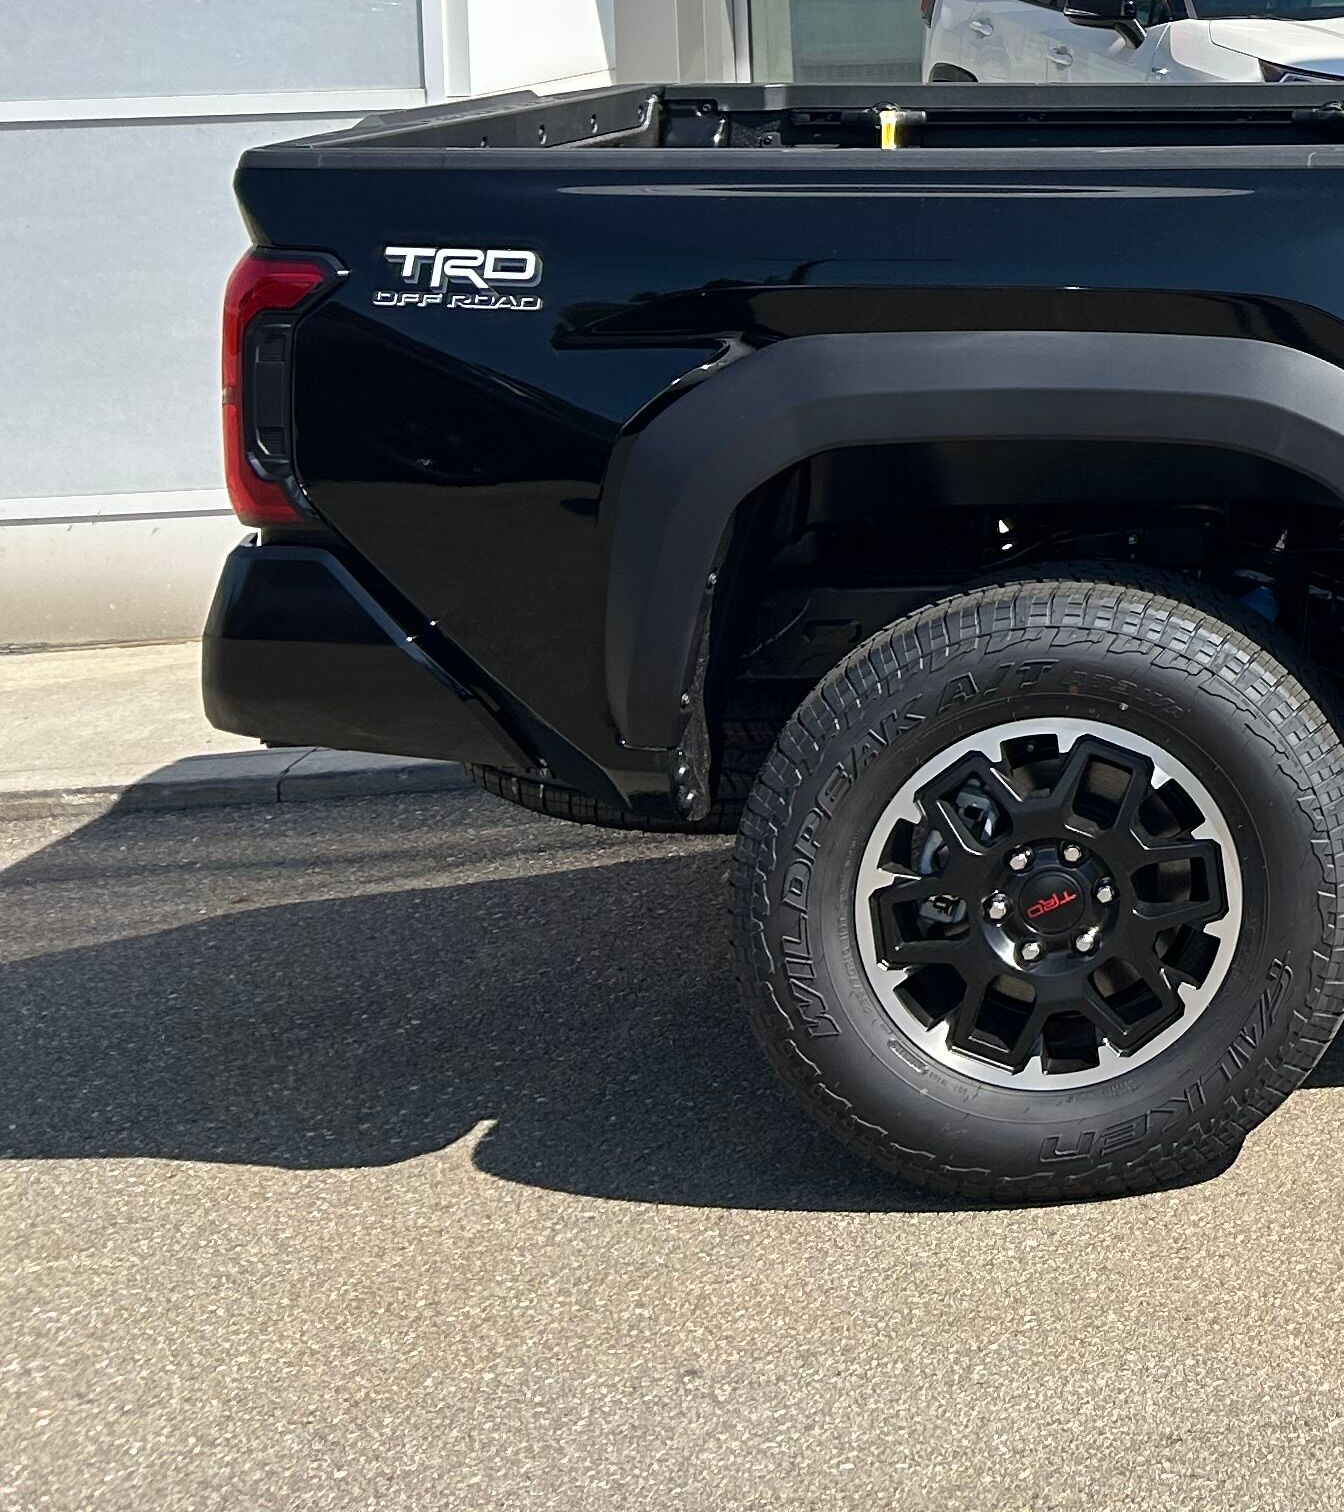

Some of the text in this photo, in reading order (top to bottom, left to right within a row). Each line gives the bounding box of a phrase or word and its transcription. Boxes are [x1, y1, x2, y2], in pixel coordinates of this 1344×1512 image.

[384, 246, 543, 295] TRD
[373, 291, 543, 311] OFF ROAD
[783, 693, 926, 1038] WILDPEAK
[1027, 891, 1077, 918] TRD
